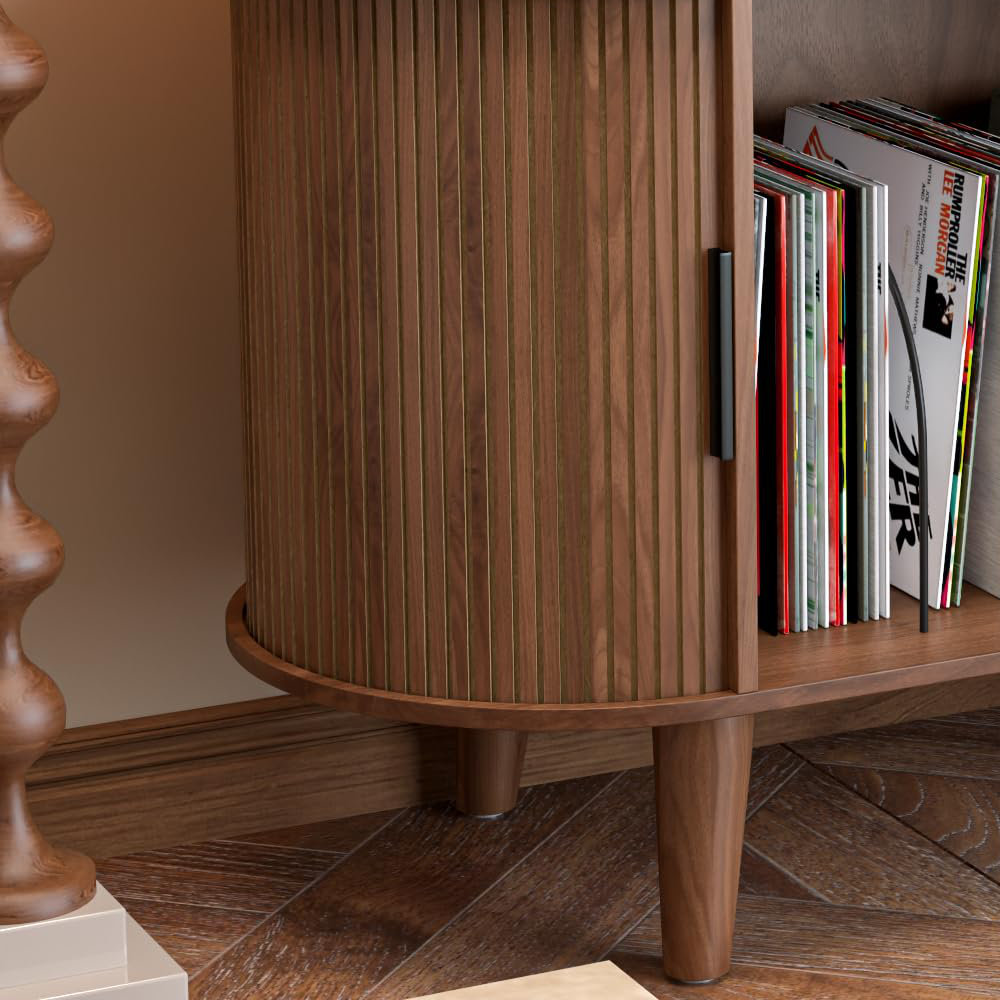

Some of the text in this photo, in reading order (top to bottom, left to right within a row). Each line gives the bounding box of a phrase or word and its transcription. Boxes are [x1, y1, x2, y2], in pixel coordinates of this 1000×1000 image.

[934, 169, 955, 276] LEE MORGAN
[945, 172, 965, 280] RUMPROLLER
[955, 252, 968, 285] THE
